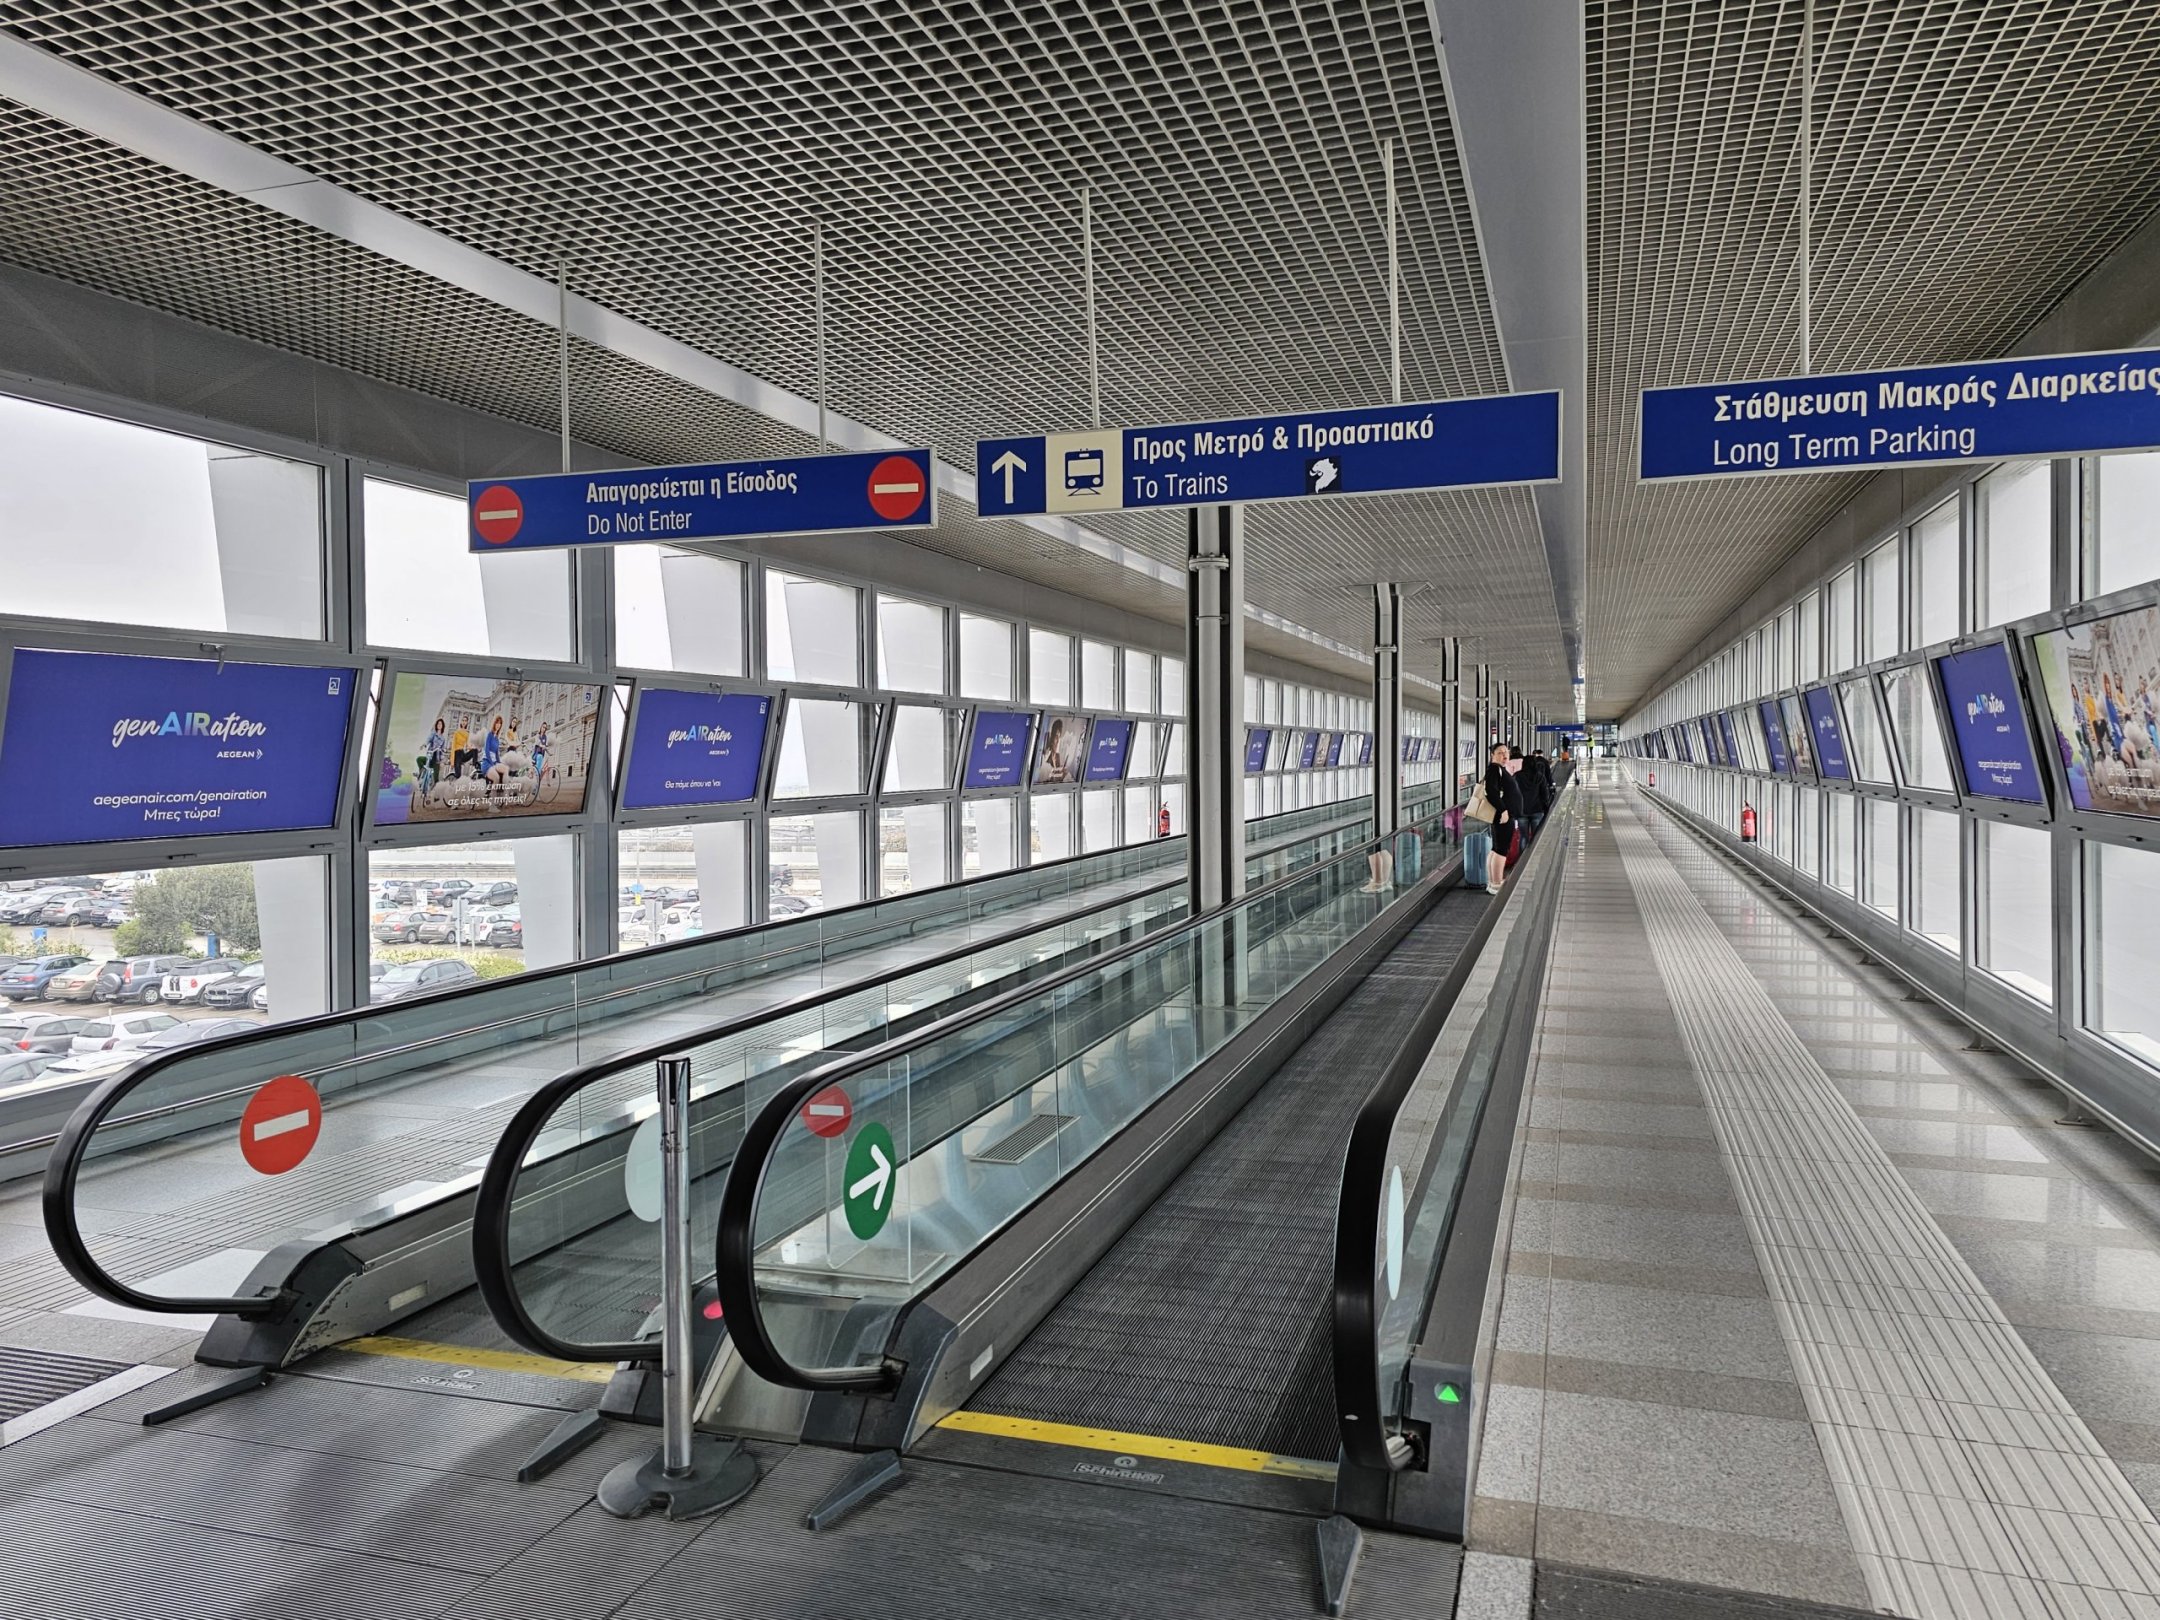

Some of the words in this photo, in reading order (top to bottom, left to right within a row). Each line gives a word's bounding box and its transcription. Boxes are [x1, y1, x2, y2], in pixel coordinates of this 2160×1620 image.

[1714, 390, 1867, 422] Στάθμευση
[1878, 375, 1997, 410] Μακράς
[2006, 363, 2160, 403] Διαρκείας
[1133, 435, 1186, 464] Προς
[1194, 426, 1264, 460] Μετρό
[1272, 426, 1289, 449] &
[1297, 414, 1434, 453] Προαστιακό
[1713, 438, 1780, 468] Long
[1789, 433, 1859, 460] Term
[1870, 424, 1976, 456] Parking
[586, 477, 705, 505] Απαγορεύεται
[711, 480, 721, 499] η
[727, 469, 798, 494] Είσοδος
[1133, 475, 1159, 499] To
[1164, 472, 1228, 496] Trains
[588, 514, 610, 535] Do
[616, 512, 645, 533] Not
[649, 510, 692, 531] Enter
[112, 711, 267, 748] genAIRation
[667, 725, 732, 748] genAIRation
[216, 750, 255, 759] AEGEAN
[93, 789, 267, 808] aegeanair.com/genairation
[144, 808, 181, 822] Μπες
[184, 807, 221, 820] τώρα!
